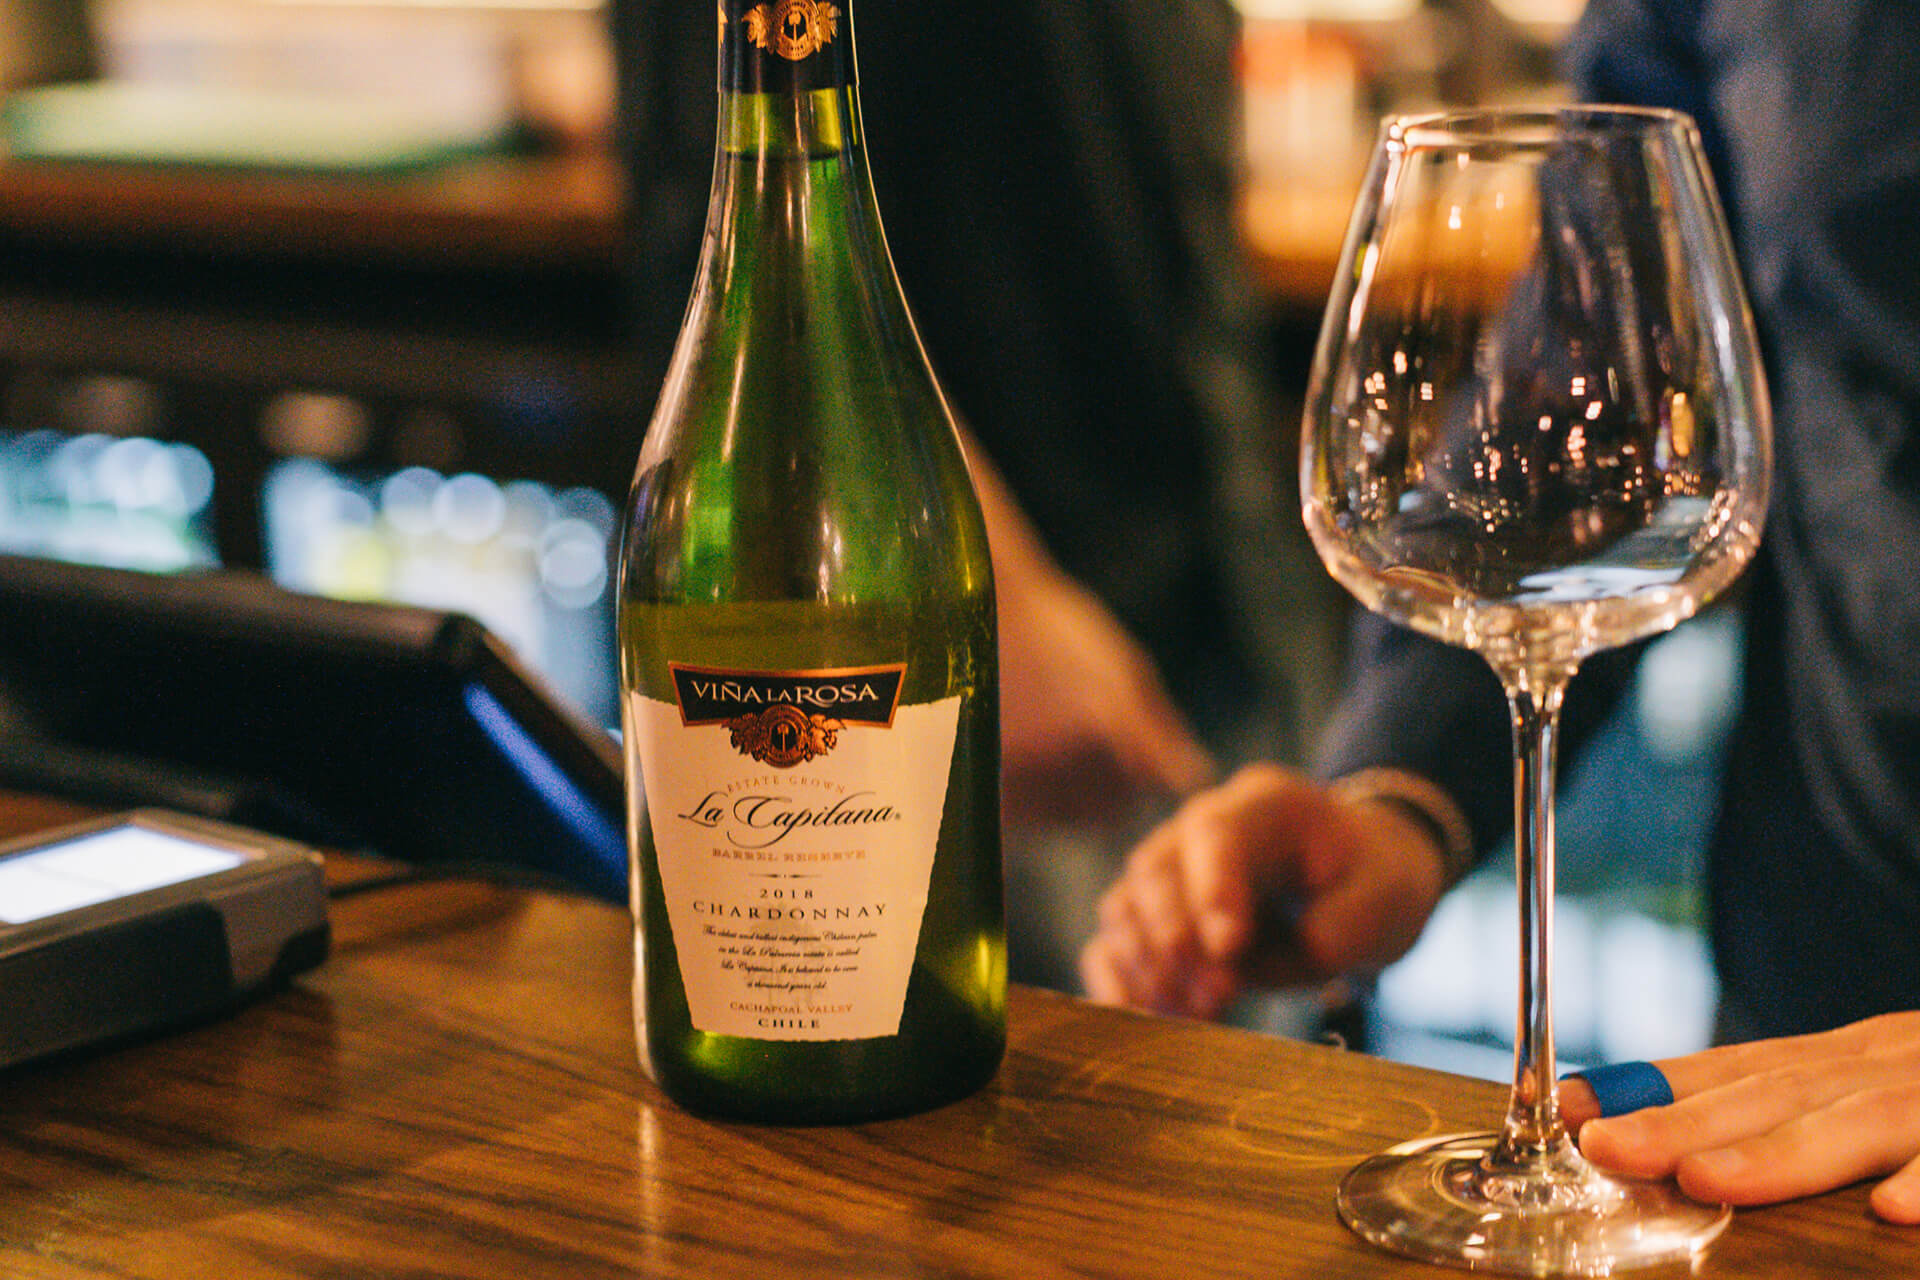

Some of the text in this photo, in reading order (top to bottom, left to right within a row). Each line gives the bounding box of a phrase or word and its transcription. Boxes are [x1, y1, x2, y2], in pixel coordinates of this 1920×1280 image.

[692, 680, 879, 708] VIÑA LA ROSA
[727, 775, 845, 794] ESTATE GROWN
[677, 791, 730, 828] La
[760, 889, 814, 899] 2018
[693, 901, 886, 921] CHARDONNAY
[807, 1003, 853, 1014] VALLEY
[758, 1018, 820, 1029] CHILE
